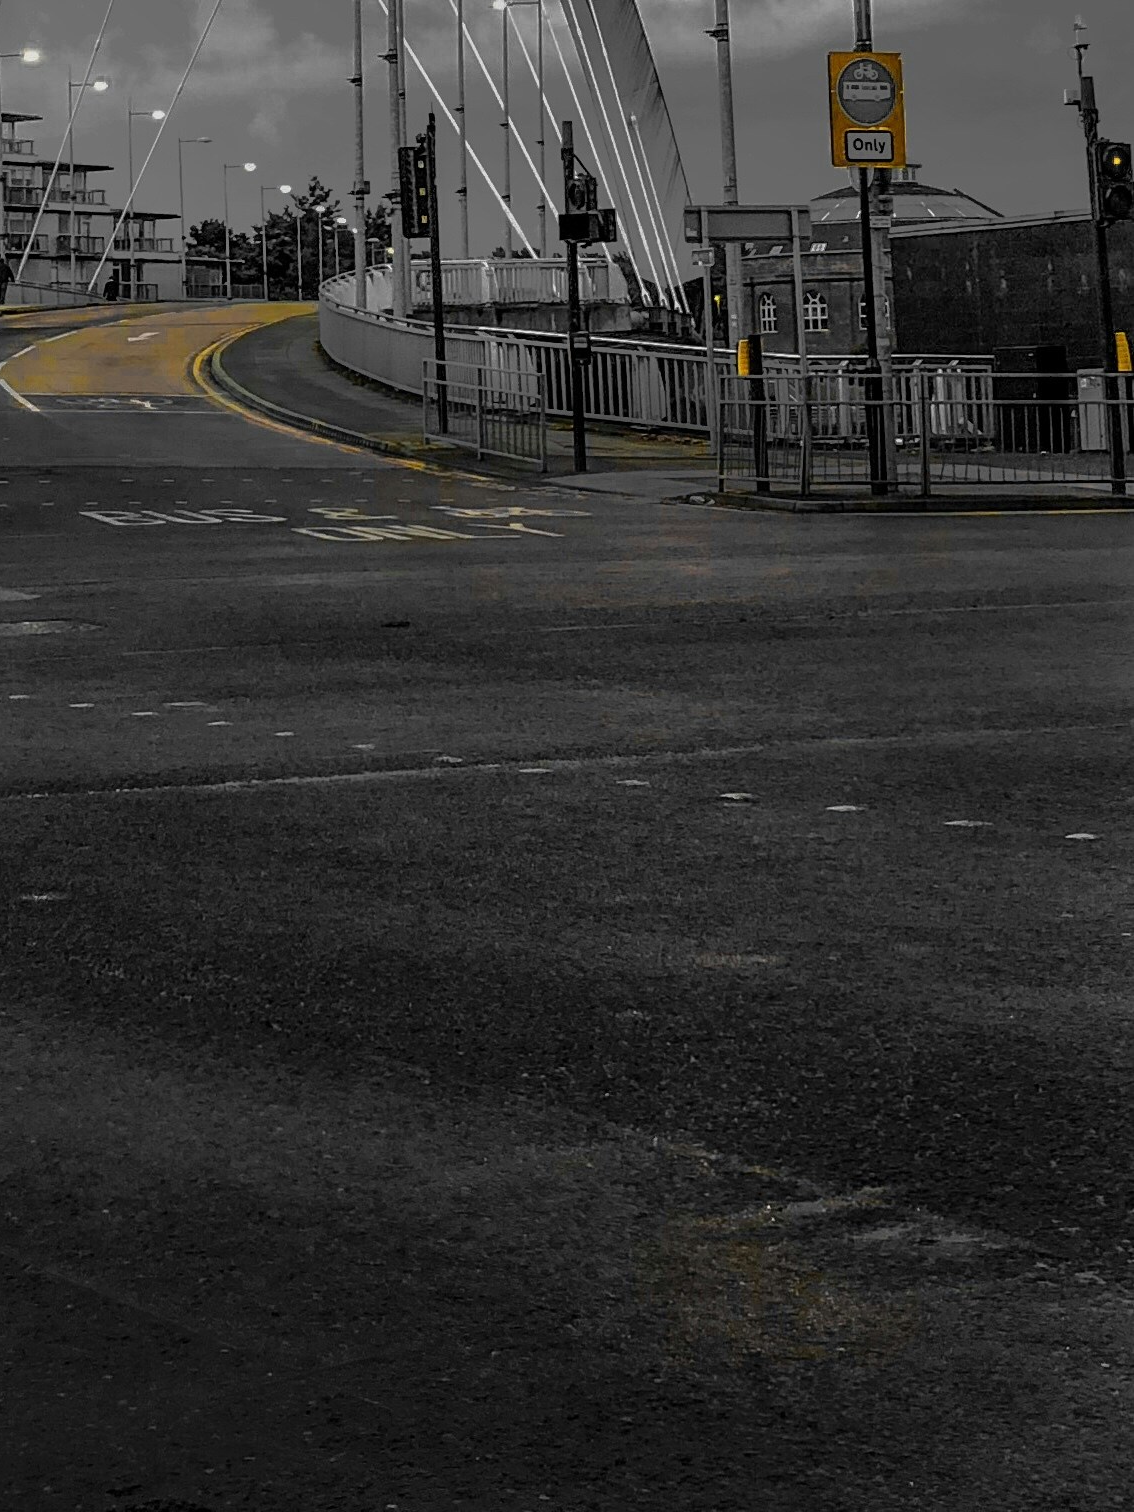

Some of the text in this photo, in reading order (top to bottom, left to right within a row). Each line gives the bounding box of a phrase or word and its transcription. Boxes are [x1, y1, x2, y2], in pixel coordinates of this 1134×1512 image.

[853, 138, 886, 154] Only
[79, 507, 399, 526] BUS &
[291, 522, 565, 542] ONLY
